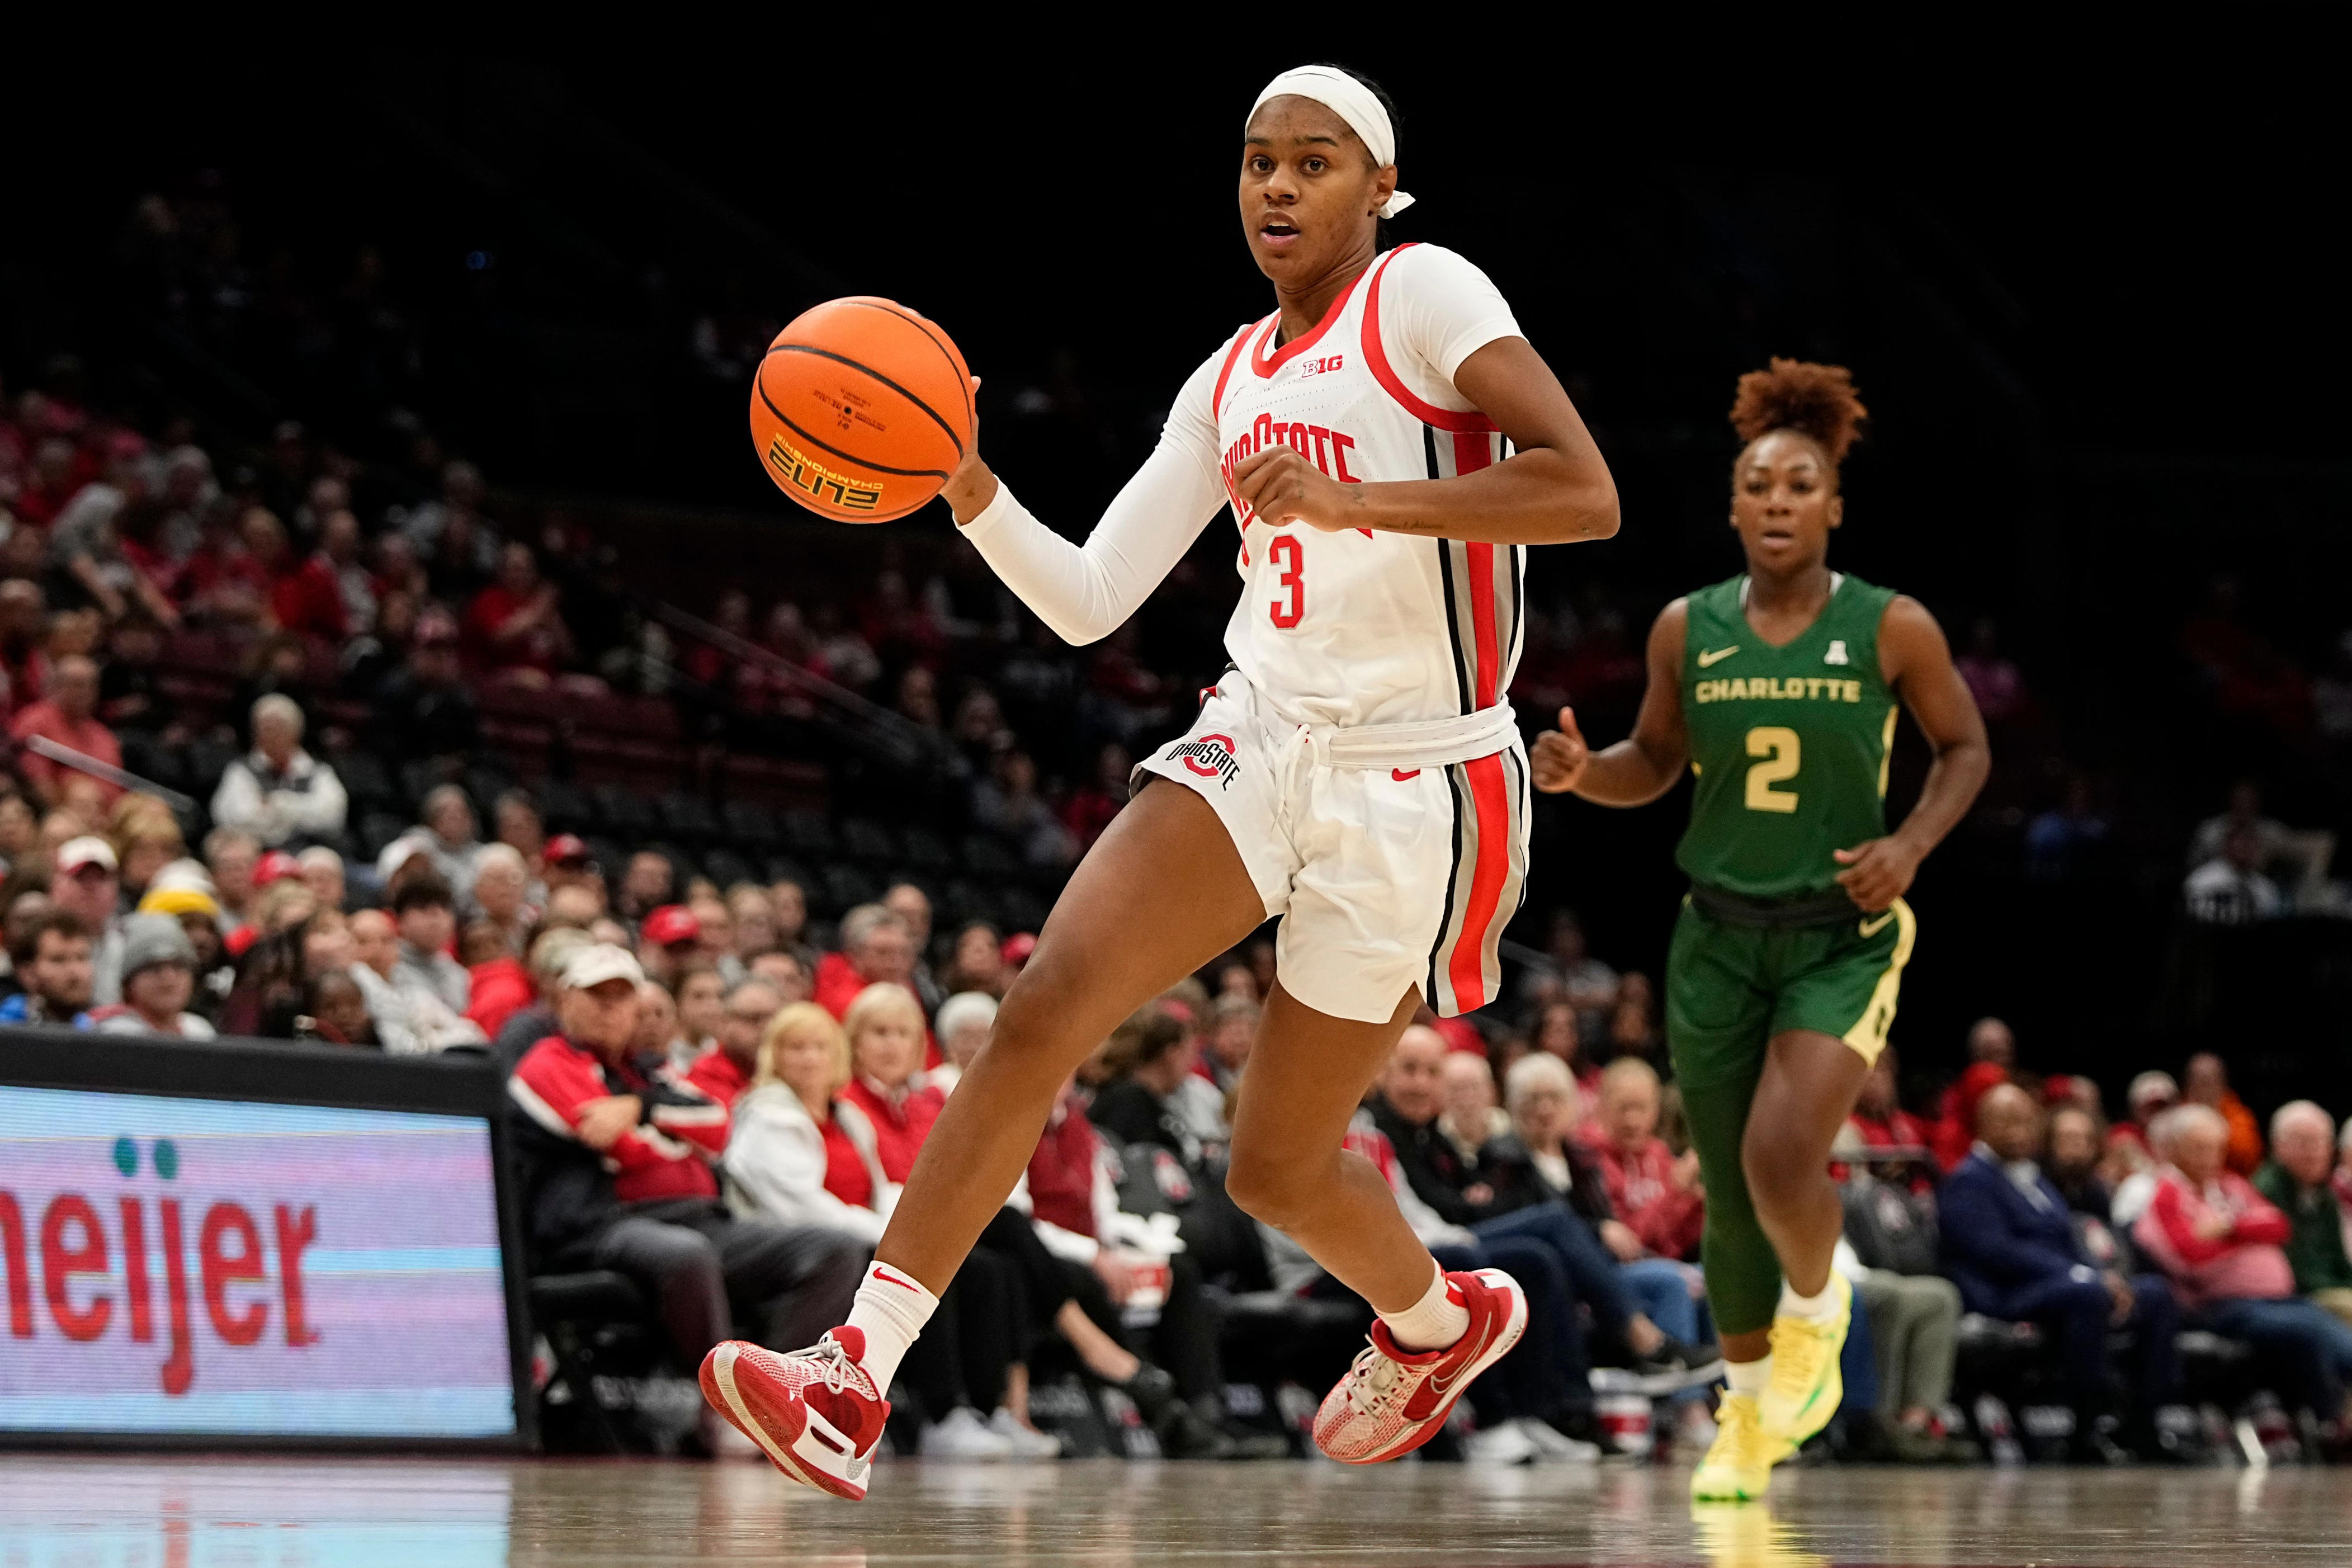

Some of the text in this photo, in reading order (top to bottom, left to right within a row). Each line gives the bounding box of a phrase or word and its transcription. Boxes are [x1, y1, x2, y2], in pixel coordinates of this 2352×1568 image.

[768, 437, 881, 511] ELITE
[775, 432, 884, 490] CHAMPIONSHIP
[1269, 533, 1305, 631] 3
[1695, 677, 1862, 704] CHARLOTTE
[1165, 743, 1240, 792] OHIO STATE
[1744, 726, 1801, 814] 2
